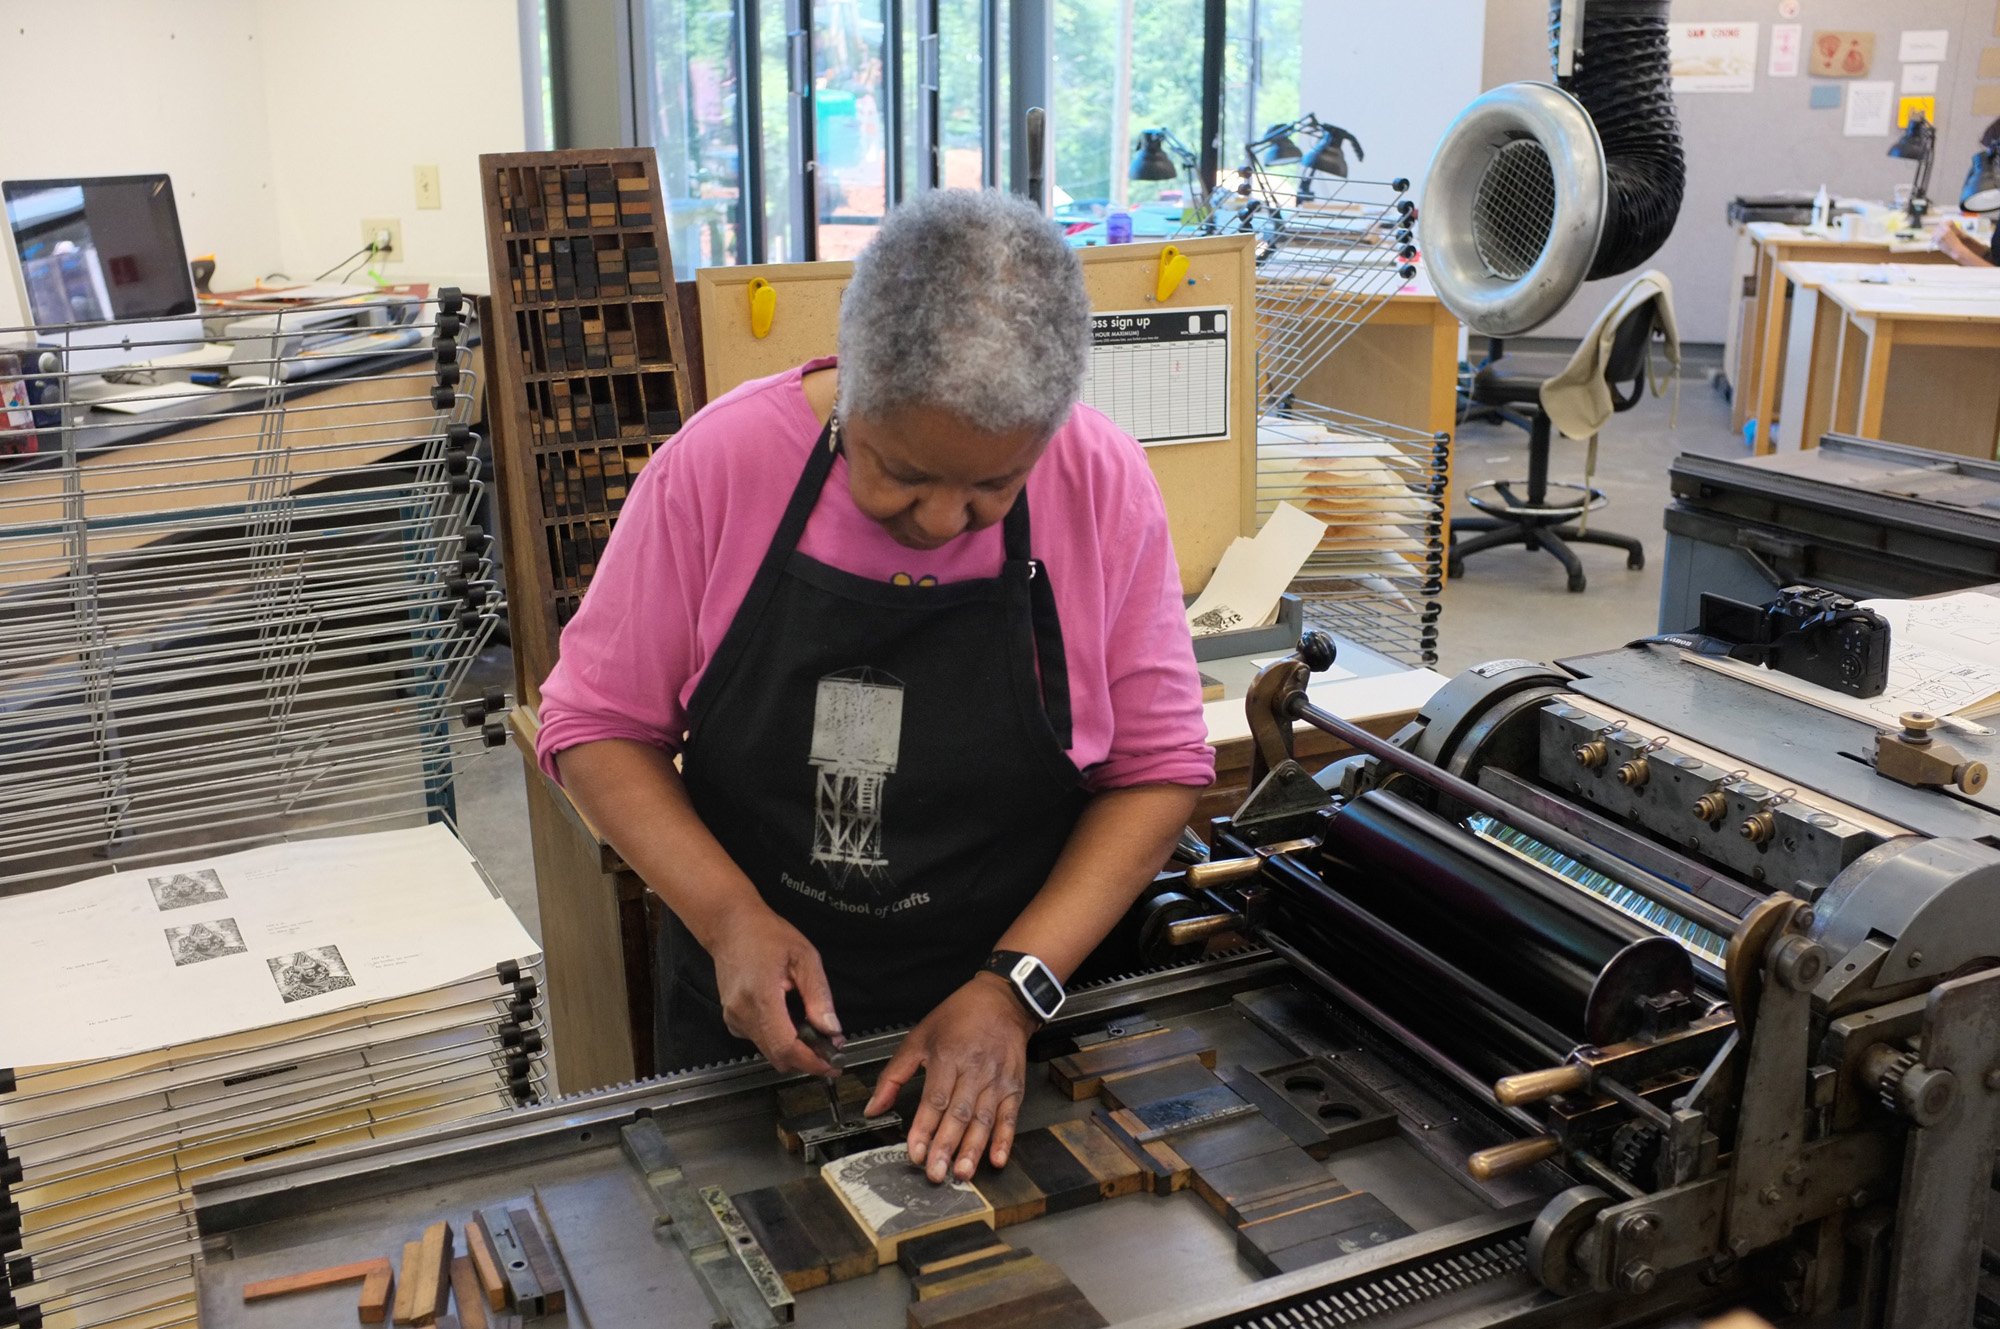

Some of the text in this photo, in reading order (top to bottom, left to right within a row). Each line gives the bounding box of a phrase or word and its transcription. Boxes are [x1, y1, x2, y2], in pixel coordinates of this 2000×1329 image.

[1111, 315, 1133, 330] sign
[1136, 317, 1150, 329] up
[780, 872, 931, 919] Penland School of Crafts
